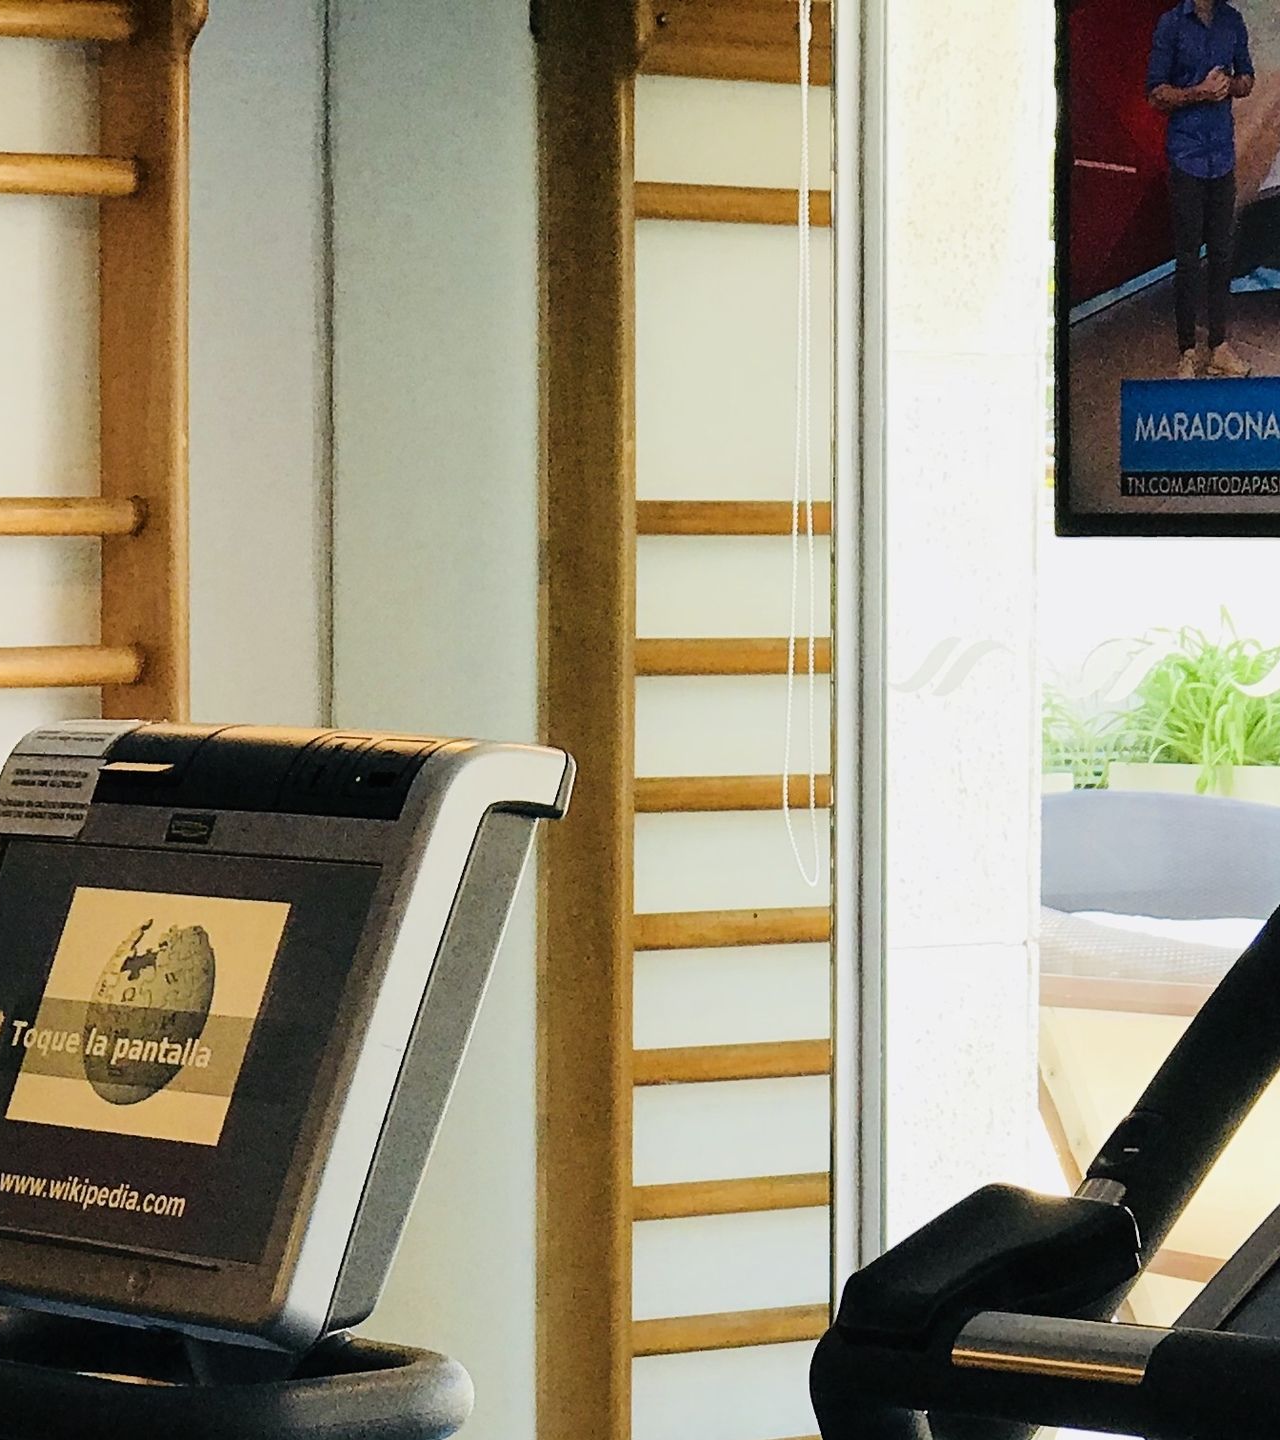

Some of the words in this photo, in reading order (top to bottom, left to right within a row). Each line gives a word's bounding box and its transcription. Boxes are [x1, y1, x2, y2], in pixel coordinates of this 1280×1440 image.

[10, 1019, 80, 1055] Toque
[84, 1026, 109, 1057] la
[109, 1036, 212, 1069] pantalla
